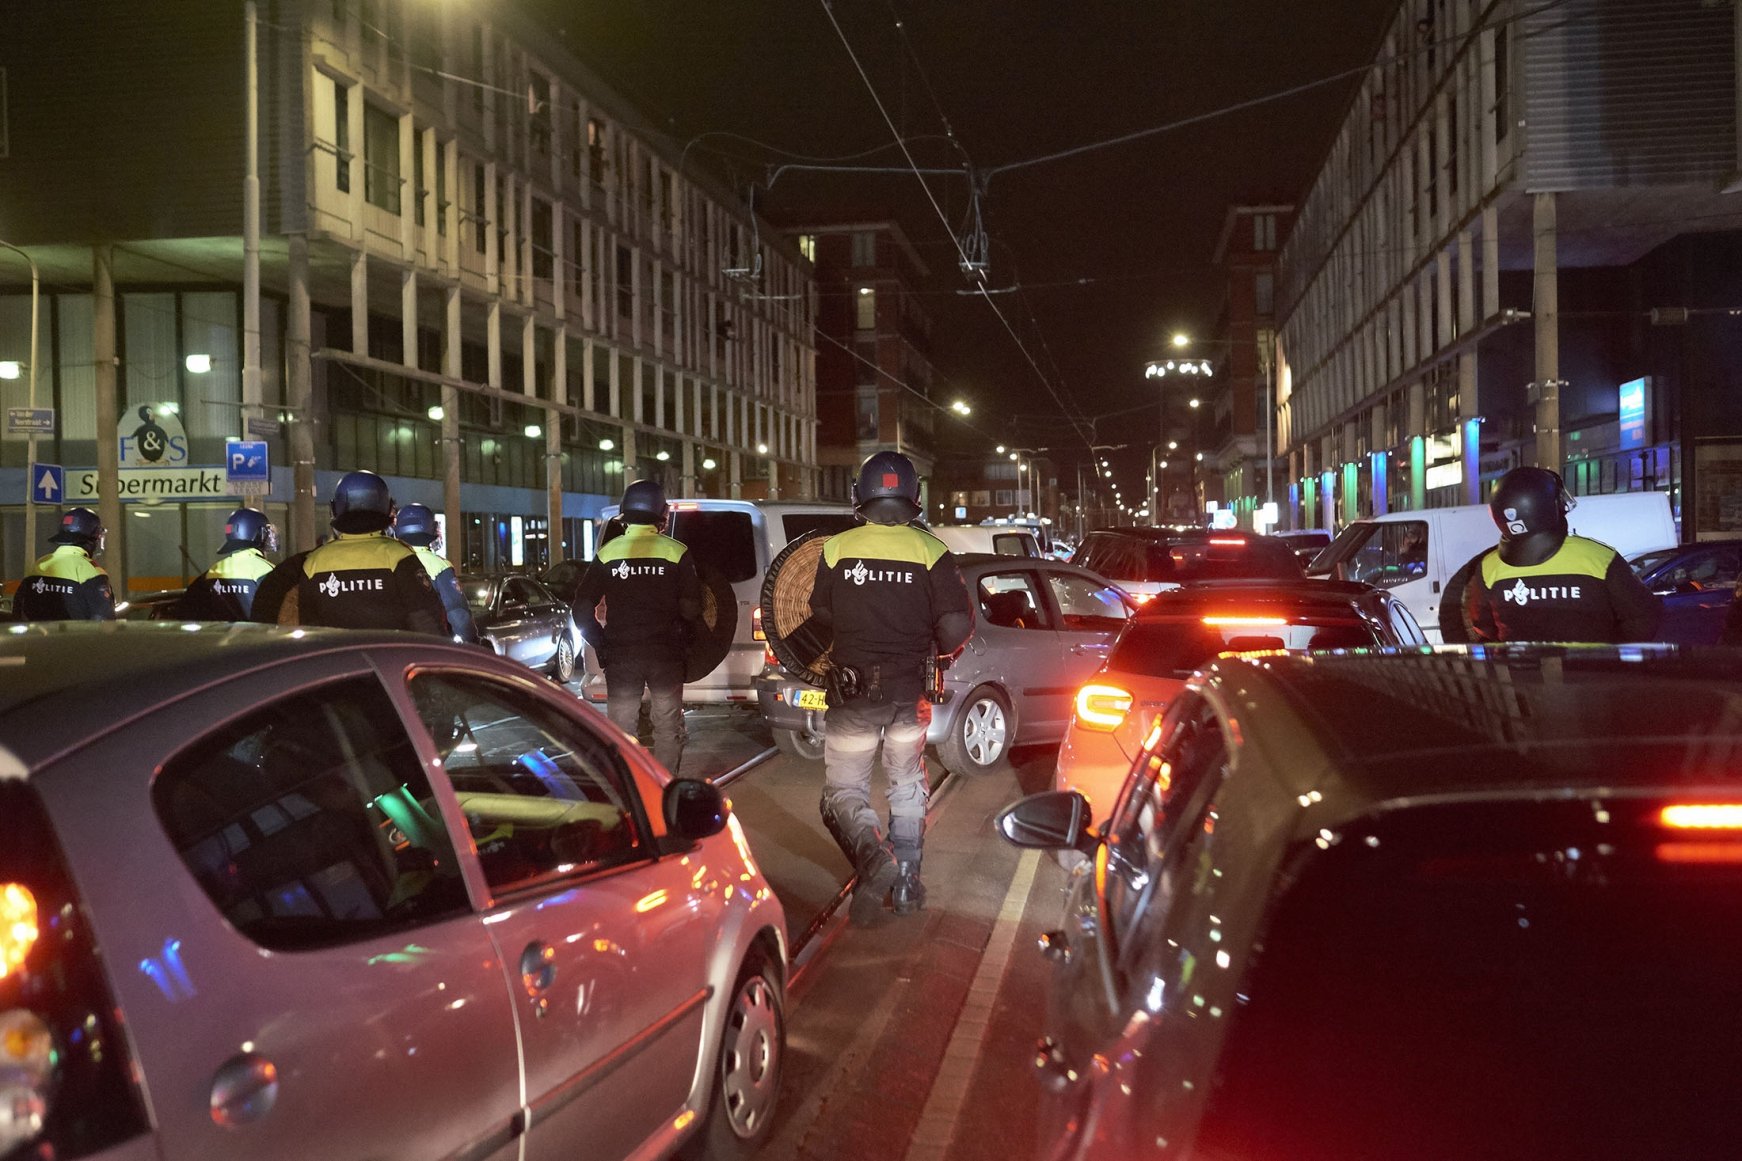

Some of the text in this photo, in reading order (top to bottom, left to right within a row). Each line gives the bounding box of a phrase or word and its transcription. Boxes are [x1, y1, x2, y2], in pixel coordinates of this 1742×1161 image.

[143, 431, 161, 450] &
[169, 435, 187, 462] S
[232, 453, 245, 471] P
[80, 470, 221, 496] Sermarkt
[611, 559, 665, 580] POLITIE
[844, 559, 913, 586] POLITIE
[212, 578, 250, 596] LITIE
[319, 572, 383, 597] POLITIE
[1503, 578, 1581, 606] POLITIE
